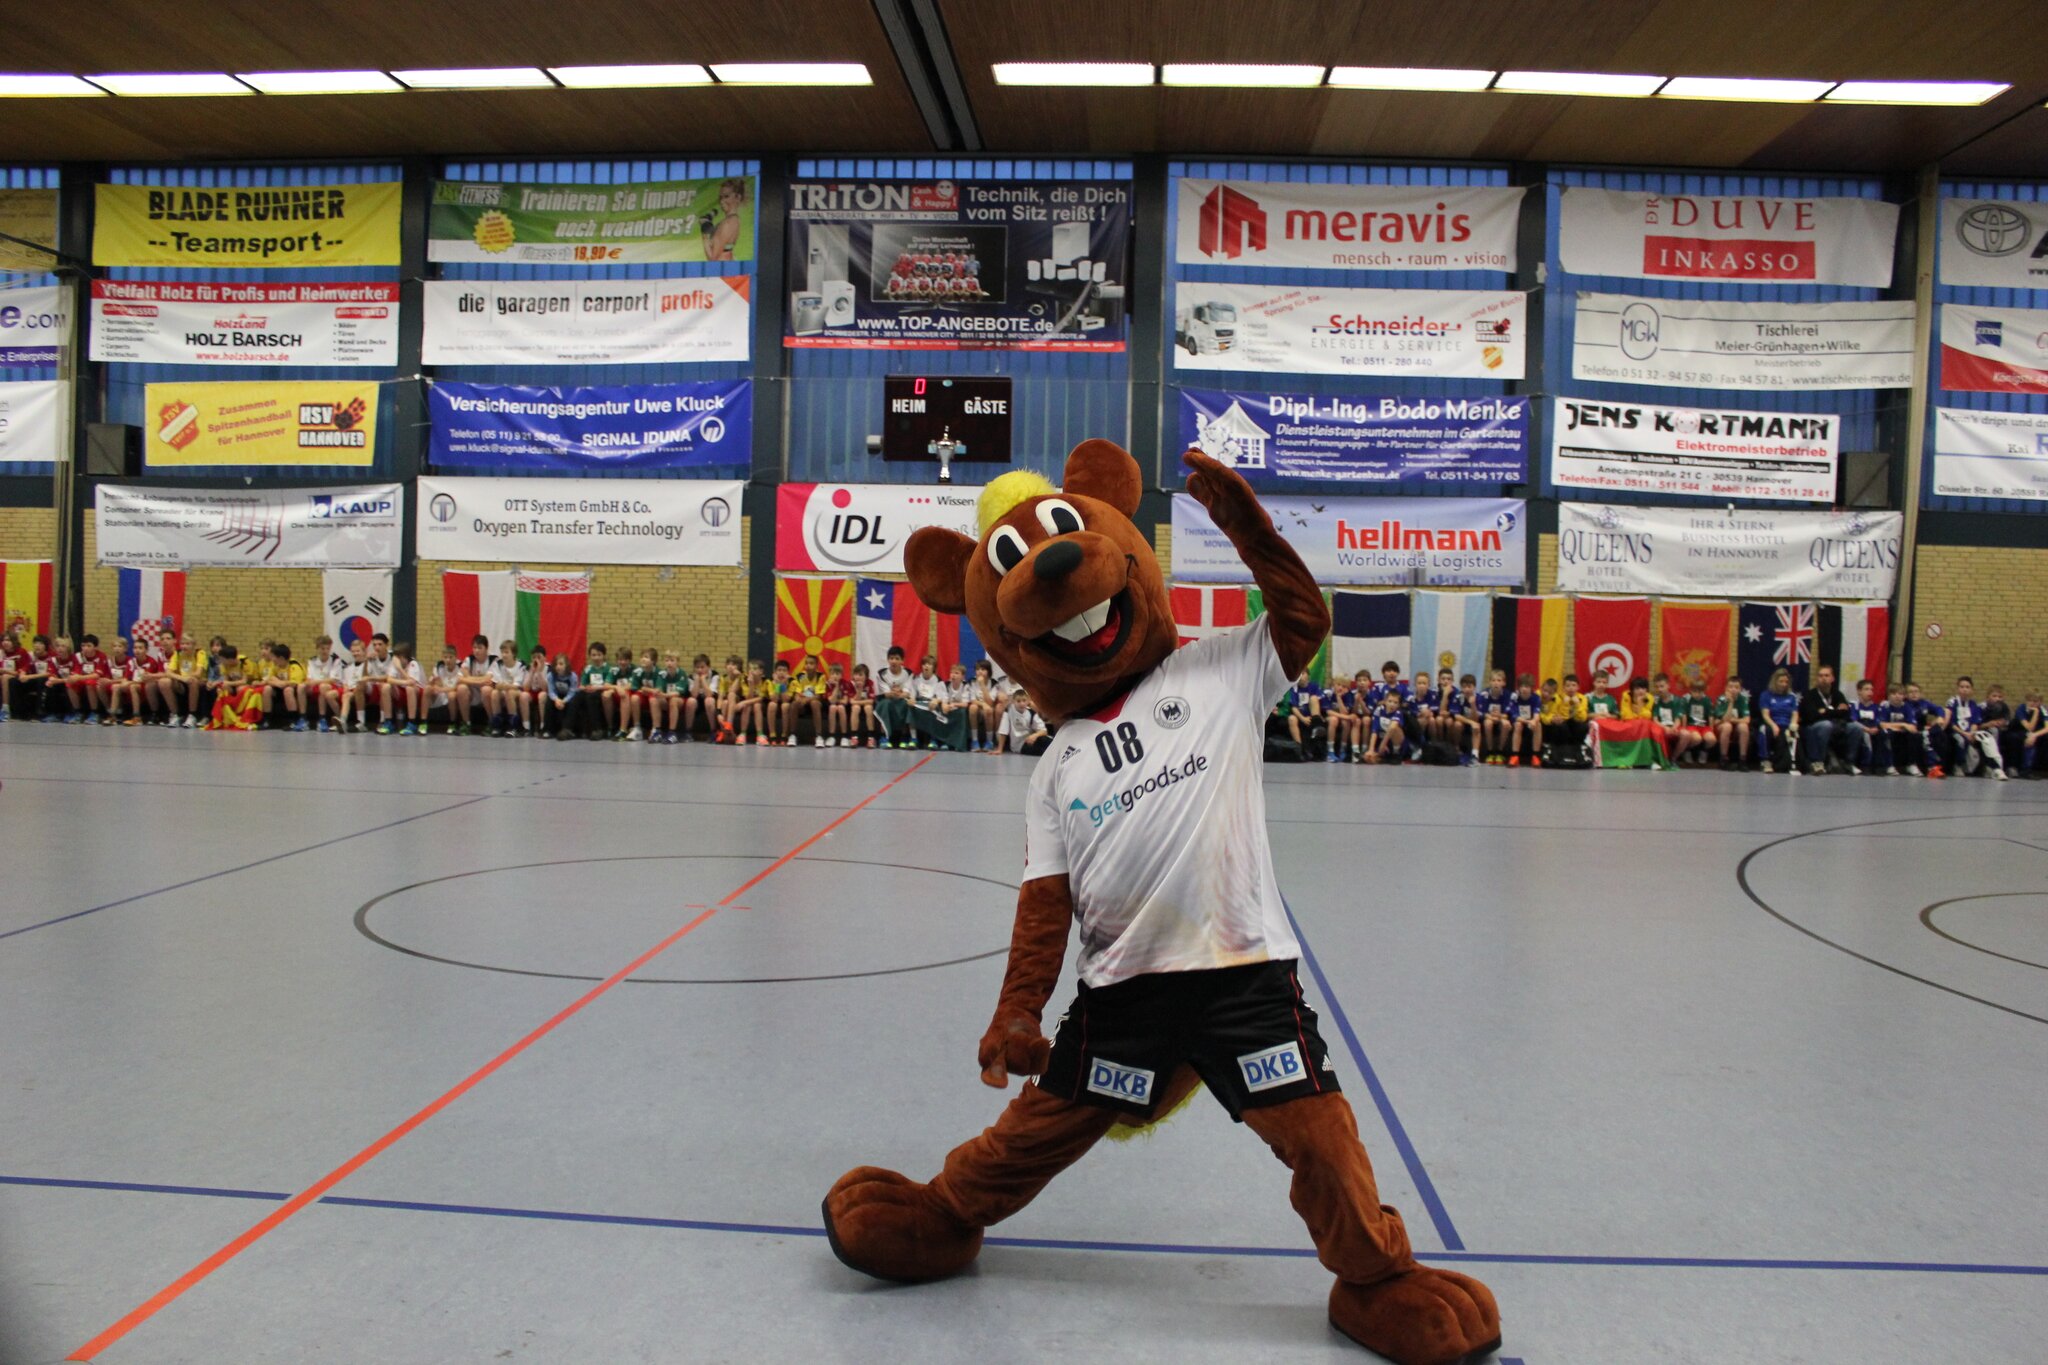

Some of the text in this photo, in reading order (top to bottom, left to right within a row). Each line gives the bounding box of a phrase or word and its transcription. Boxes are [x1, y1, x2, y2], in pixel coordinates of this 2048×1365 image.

[521, 187, 697, 212] Trainieren Sie immer
[912, 186, 932, 195] Cash
[967, 187, 1126, 205] Technik, die Dich
[149, 189, 346, 222] BLADE RUNNER
[913, 198, 951, 209] & Happy
[966, 207, 1007, 221] vom
[1012, 205, 1047, 221] Sitz
[1053, 205, 1095, 221] reißt
[1671, 197, 1816, 231] DUVE
[555, 214, 696, 238] noch woanders?
[1285, 202, 1471, 243] meravis
[608, 247, 624, 260] €
[1332, 252, 1507, 266] mensch raum vision
[1660, 249, 1800, 271] INKASSO
[102, 283, 391, 301] Vielfalt Holz für Profis und Heimwerker
[458, 290, 714, 315] die garagen carport profis
[857, 315, 1054, 333] www.TOP-ANGEBOTE.de
[1329, 314, 1450, 336] Schneider
[1621, 319, 1659, 342] MGW
[1755, 324, 1819, 336] Tischlerei
[186, 331, 303, 347] HOLZ BARSCH
[1311, 337, 1462, 351] ENERGIE & SERVICE
[7, 352, 62, 363] Enterprises
[1363, 356, 1385, 366] 0511
[1394, 357, 1412, 366] 280
[1582, 364, 1619, 377] Telefon
[914, 378, 926, 394] 0
[218, 399, 277, 416] Zusammen
[450, 395, 725, 419] Versicherungsagentur Uwe Kluck
[892, 398, 926, 413] HEIM
[964, 396, 1008, 415] GÄSTE
[1269, 396, 1522, 424] Dipl.-Ing. Bodo Menke
[207, 410, 292, 433] Spitzenhandball
[300, 405, 334, 425] HSV
[1566, 403, 1641, 431] JENS
[217, 428, 286, 446] für Hannover
[299, 431, 366, 447] HANNOVER
[449, 429, 480, 439] Telefon
[582, 429, 692, 447] SIGNAL IDUNA
[1276, 423, 1522, 440] Dienstleistungsunternehmen im Gartenbau
[1676, 439, 1828, 458] Elektromeisterbetrieb
[334, 501, 391, 515] KAUP
[504, 499, 652, 516] OTT System GmbH & Co.
[936, 496, 974, 506] Wissen
[473, 518, 684, 540] Oxygen Transfer Technology
[829, 514, 886, 545] IDL
[1691, 518, 1775, 531] IHR 4 STERNE
[1337, 520, 1502, 551] hellmann
[1560, 528, 1653, 565] QUEENS
[1707, 548, 1778, 560] HANNOVER
[1809, 536, 1899, 572] QUEENS
[1337, 552, 1502, 571] Worldwide Logistics
[1095, 721, 1145, 774] 08
[1089, 753, 1209, 828] getgoods.de
[1244, 1051, 1299, 1085] DKB
[1093, 1065, 1149, 1097] DKB
